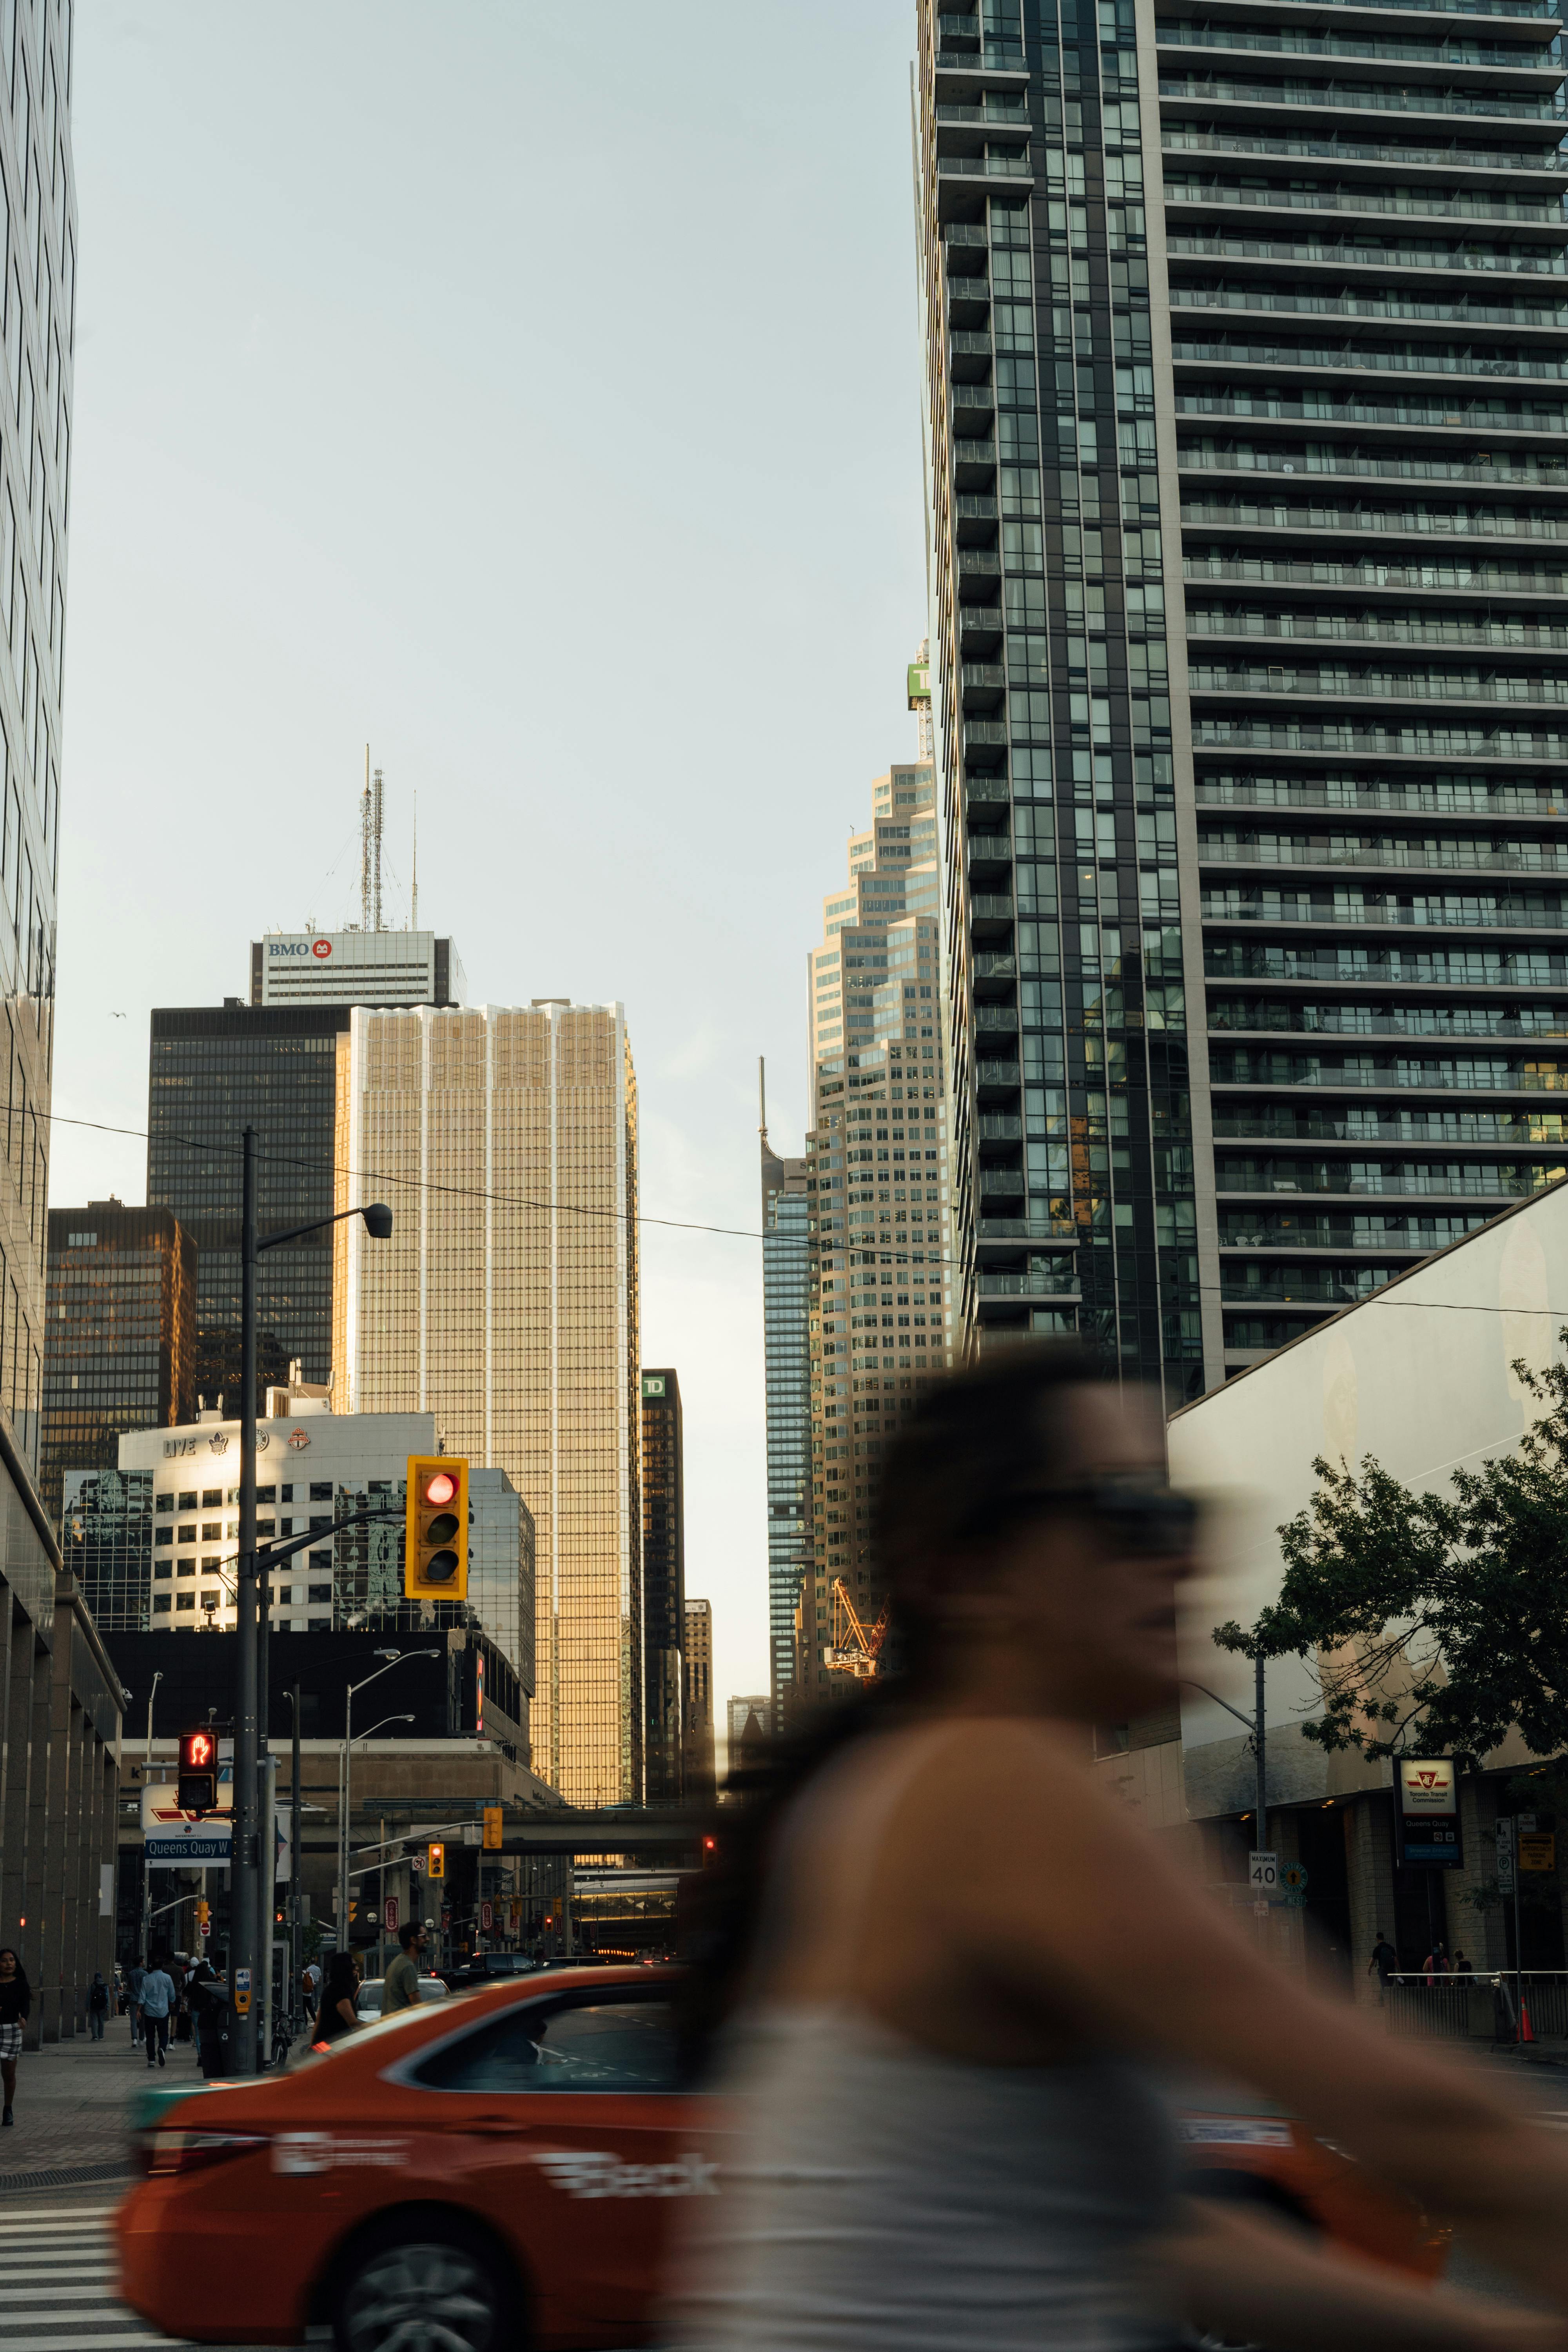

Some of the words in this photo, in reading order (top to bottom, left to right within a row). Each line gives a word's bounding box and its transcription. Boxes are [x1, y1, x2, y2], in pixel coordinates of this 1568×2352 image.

[269, 944, 309, 956] BMO
[644, 1380, 663, 1393] TD
[163, 1437, 196, 1457] LIVE
[149, 1842, 187, 1855] Queens
[191, 1841, 216, 1857] Quay
[219, 1841, 228, 1853] W
[1252, 1867, 1275, 1884] 40
[1282, 1863, 1305, 1875] GARDINER
[1280, 1878, 1307, 1893] EXPRESSWAY
[1288, 1896, 1303, 1906] WEST
